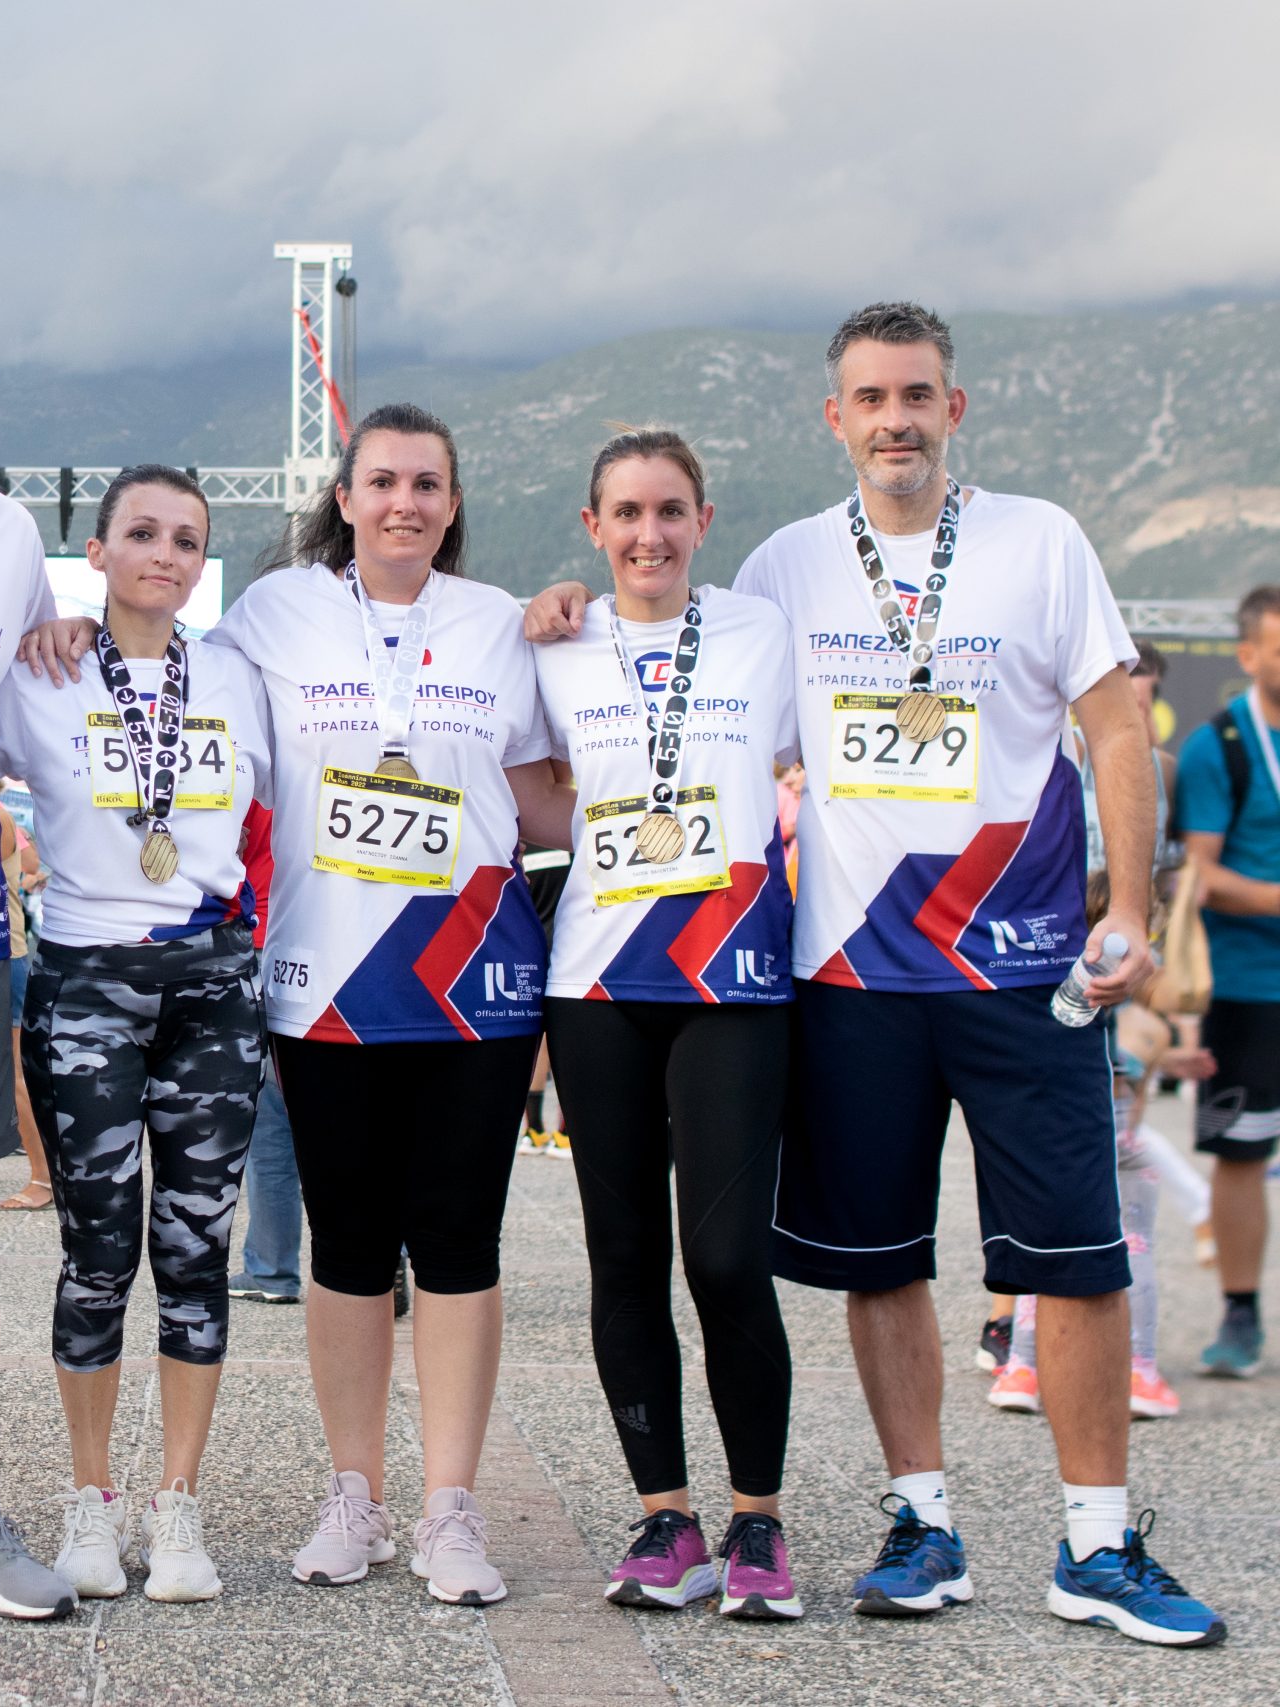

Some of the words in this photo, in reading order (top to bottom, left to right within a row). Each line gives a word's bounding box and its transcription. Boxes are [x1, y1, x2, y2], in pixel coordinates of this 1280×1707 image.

[809, 633, 894, 652] ΤΡΑΠΕΖ
[938, 637, 1002, 654] ΕΙΡΟΥ
[300, 683, 375, 698] ΤΡΑΠΕ
[807, 676, 814, 686] Η
[818, 675, 877, 688] ΤΡΑΠΕΖΑ
[885, 678, 903, 688] ΤΟ
[971, 680, 999, 691] ΜΑΣ
[693, 699, 749, 714] ΕΙΡΟΥ
[300, 724, 308, 734] Η
[313, 721, 379, 732] ΤΡΑΠΕΖΑ
[422, 721, 471, 734] ΤΟΠΟΥ
[474, 727, 495, 742] ΜΑΣ
[658, 711, 685, 762] 5-10
[585, 737, 639, 752] ΤΡΑΠΕΖΑ
[725, 733, 748, 745] ΜΑΣ
[337, 772, 367, 782] Ioannina
[370, 777, 386, 785] Lake
[328, 798, 448, 855] 5275
[595, 815, 715, 870] 522
[357, 868, 375, 876] bwin
[637, 888, 654, 896] bwin
[1053, 933, 1068, 942] Sep
[989, 960, 1024, 968] Official
[1026, 958, 1048, 966] Bank
[273, 960, 308, 987] 5275
[727, 990, 755, 998] Official
